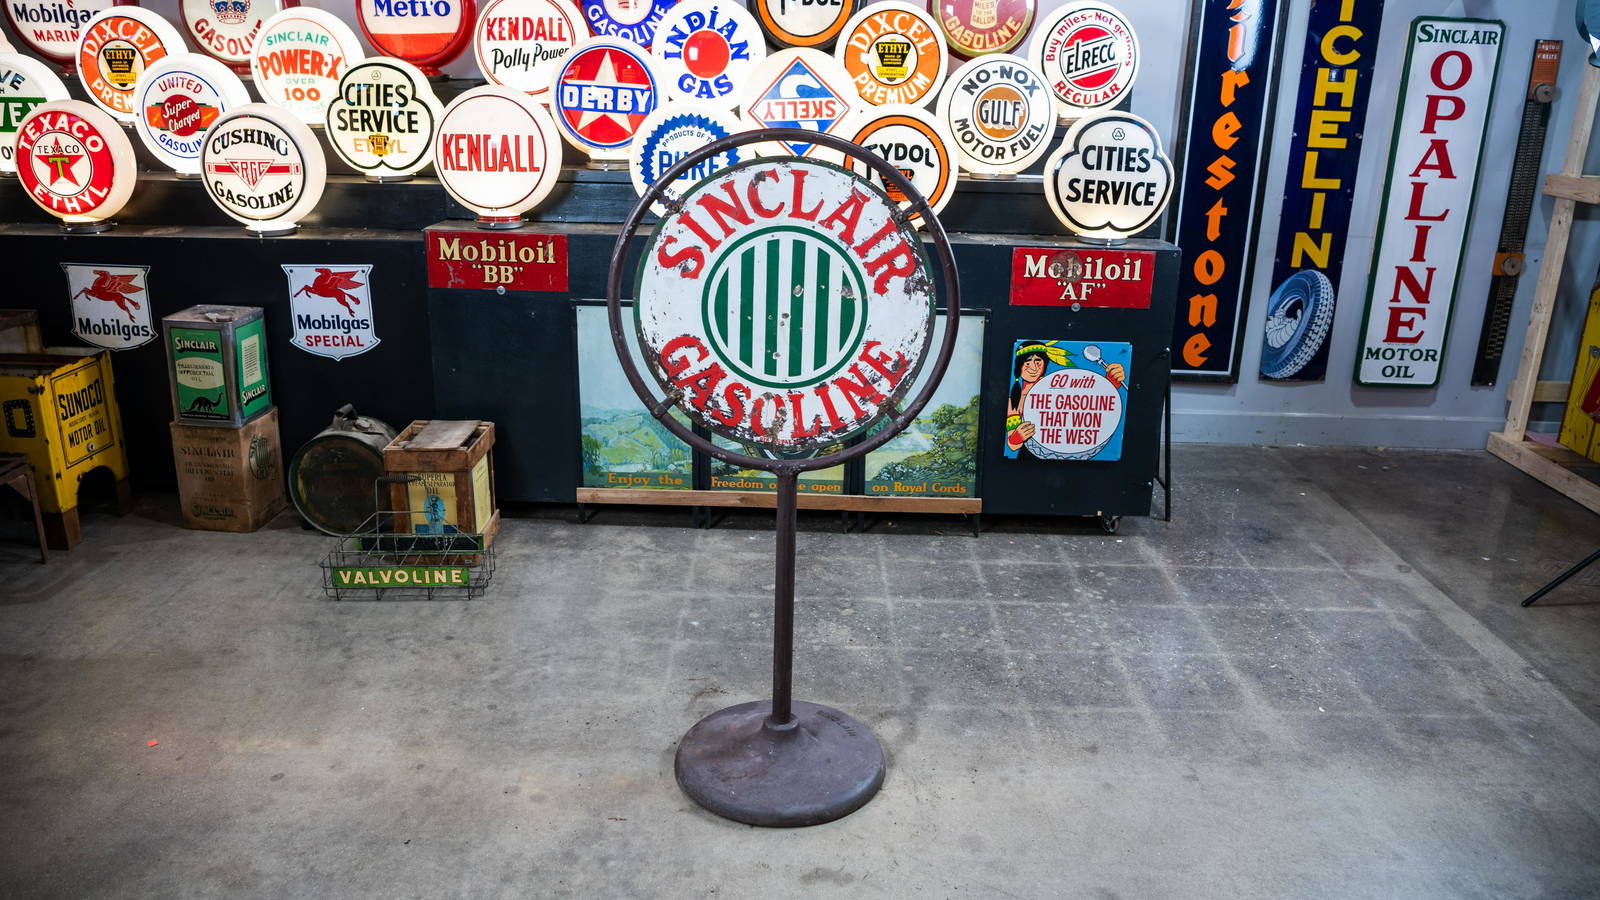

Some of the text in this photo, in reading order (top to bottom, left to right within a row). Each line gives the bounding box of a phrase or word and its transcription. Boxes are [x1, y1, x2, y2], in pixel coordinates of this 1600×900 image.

[13, 3, 101, 29] Mobilga
[374, 0, 451, 17] Metro
[33, 29, 79, 42] MARIN
[83, 19, 161, 60] DIXCEL
[266, 31, 329, 46] SINCLAIR
[486, 16, 567, 42] KENDALL
[851, 13, 936, 55] DIXCEL
[945, 16, 1021, 48] GASOLINE
[1417, 24, 1499, 45] SINCLAIR
[105, 50, 135, 59] ETHYL
[492, 43, 570, 75] Polly Power
[878, 43, 909, 53] ETHYL
[1045, 38, 1062, 61] Buy
[258, 48, 342, 81] POWER-X
[158, 76, 203, 94] UNITED
[285, 77, 315, 85] OVER
[677, 73, 734, 99] GAS
[852, 71, 931, 104] PREMIUM
[961, 65, 1041, 98] NO-NOX
[1054, 80, 1121, 105] REGULAR
[91, 77, 133, 110] PREM
[284, 87, 321, 101] 100
[345, 82, 409, 108] CITIES
[563, 85, 651, 112] DERBY
[162, 99, 192, 118] Super
[168, 109, 200, 132] Charged
[337, 108, 419, 133] SERVICE
[764, 100, 837, 120] SKELLY
[979, 99, 1023, 128] GULF
[19, 113, 104, 153] TEXACO
[159, 133, 205, 153] GASOLIN
[212, 128, 288, 156] CUSHING
[662, 130, 694, 147] PRODUCTS
[954, 117, 1045, 160] MOTOR FUEL
[1291, 0, 1363, 269] ICHELIN
[37, 145, 80, 154] TEXACO
[443, 133, 540, 172] KENDALL
[1082, 144, 1151, 173] CITIES
[214, 180, 294, 210] GASOLINE
[1066, 178, 1157, 207] SERVICE
[1183, 0, 1251, 367] irestone
[33, 183, 108, 212] ETHYL
[1382, 50, 1473, 344] OPALINE
[657, 168, 916, 296] SINCLAIR
[438, 237, 556, 264] Mobiloil
[472, 264, 523, 284] "BB"
[1023, 254, 1142, 281] Mobiloil
[1057, 280, 1106, 301] "AF"
[78, 317, 150, 341] Mobilgas
[297, 313, 370, 334] Mobilgas
[175, 336, 217, 350] SINCLAIR
[305, 335, 364, 348] SPECIAL
[1365, 347, 1438, 362] MOTOR
[1050, 374, 1096, 389] GO with
[1381, 365, 1415, 378] OIL
[241, 385, 266, 403] SINCLAIR
[660, 334, 911, 438] GASOLINE
[58, 378, 103, 420] SUNOCO
[1030, 394, 1116, 411] THE GASOLINE
[1040, 411, 1102, 428] THAT WON
[68, 423, 94, 448] MOTOR
[94, 417, 106, 435] OIL
[1040, 428, 1099, 445] THE WEST
[608, 472, 684, 486] Enjoy the
[711, 476, 764, 489] Freedom
[811, 483, 841, 492] open
[893, 482, 927, 495] Royal
[931, 482, 967, 493] Cords
[339, 569, 464, 585] VALVOLINE
